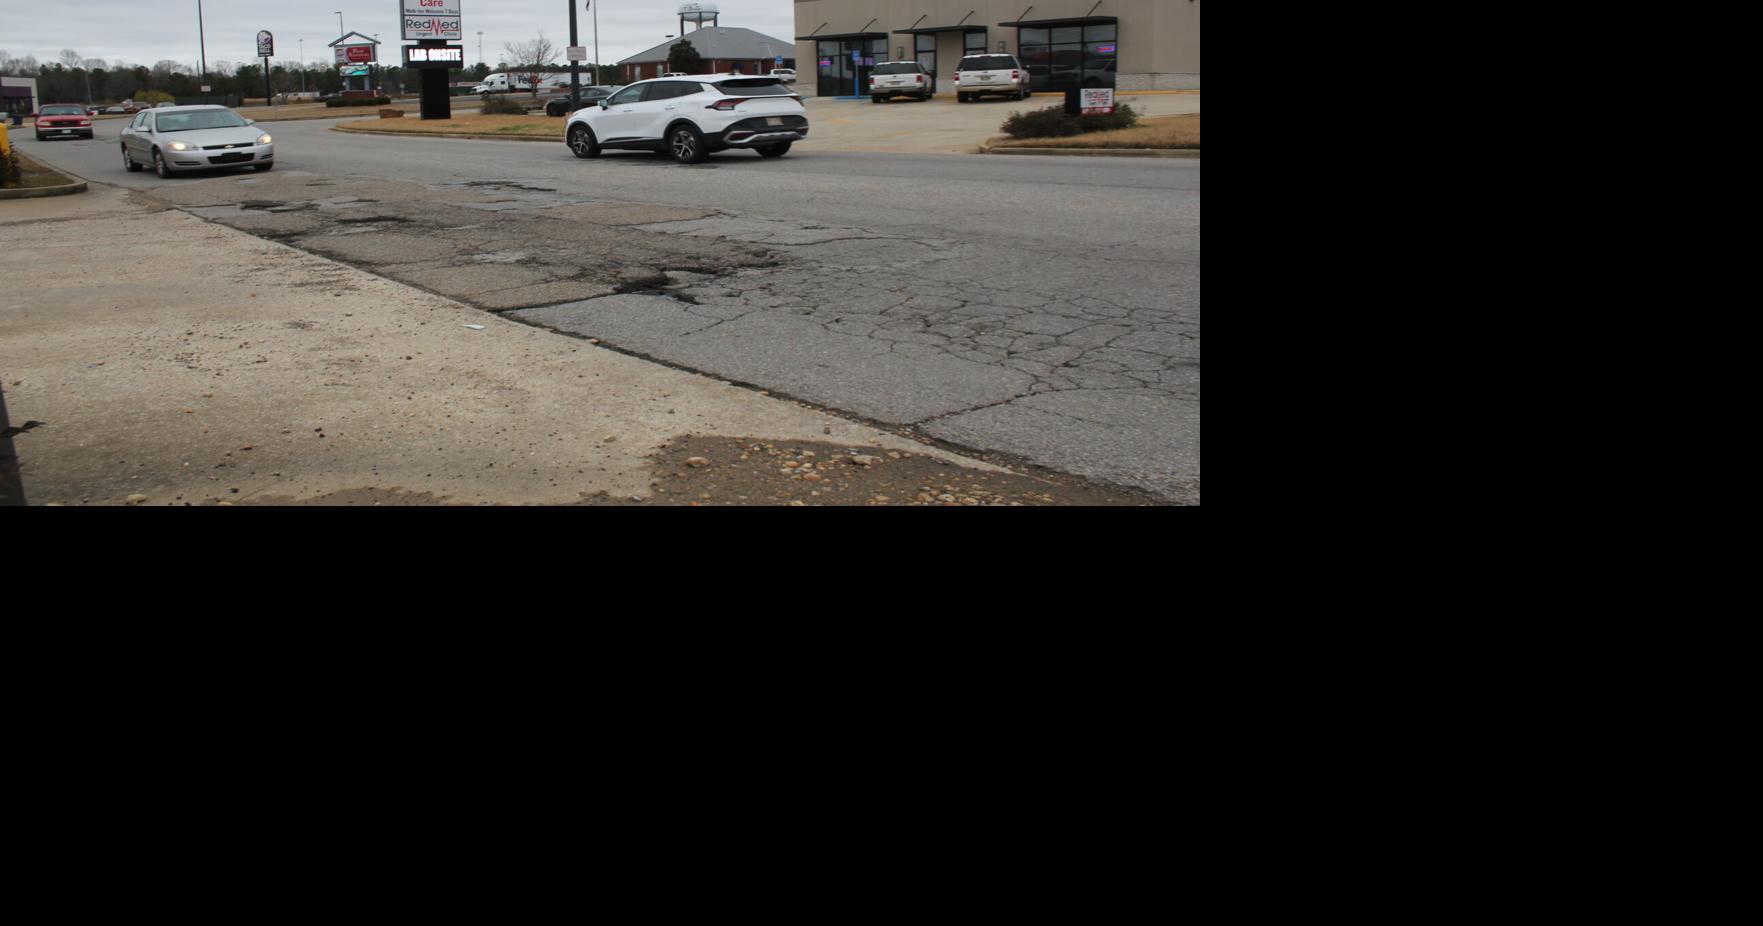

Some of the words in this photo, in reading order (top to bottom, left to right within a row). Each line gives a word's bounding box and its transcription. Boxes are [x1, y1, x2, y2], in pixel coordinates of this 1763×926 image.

[406, 18, 459, 34] RedMed
[409, 49, 427, 61] LAB
[428, 49, 461, 61] ONSITE
